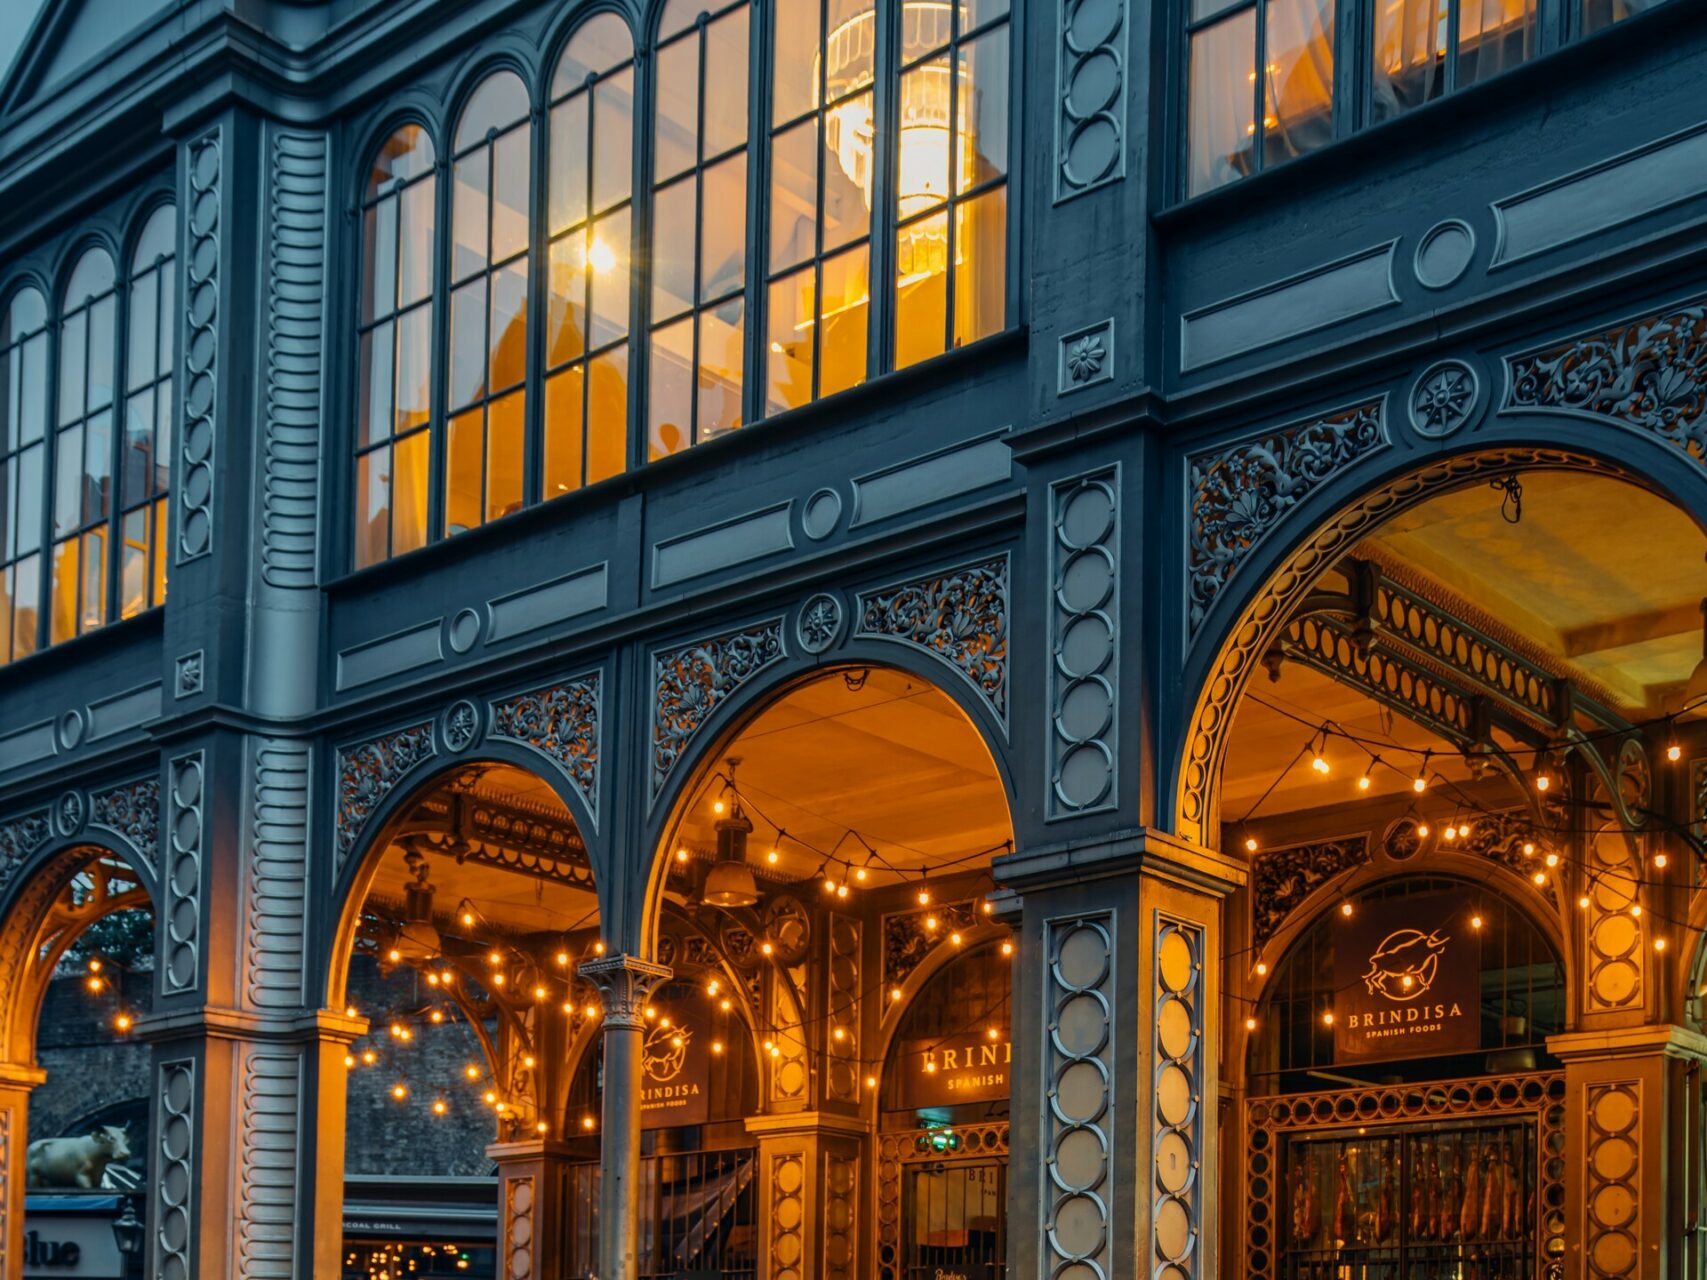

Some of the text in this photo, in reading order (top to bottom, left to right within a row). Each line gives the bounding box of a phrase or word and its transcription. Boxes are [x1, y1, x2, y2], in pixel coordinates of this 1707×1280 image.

[1348, 1003, 1462, 1029] BRINDISA
[1366, 1023, 1442, 1039] SPANISH FOODS
[947, 1073, 1004, 1090] SPANISH
[373, 1222, 402, 1231] GRILL
[24, 1230, 80, 1267] lue
